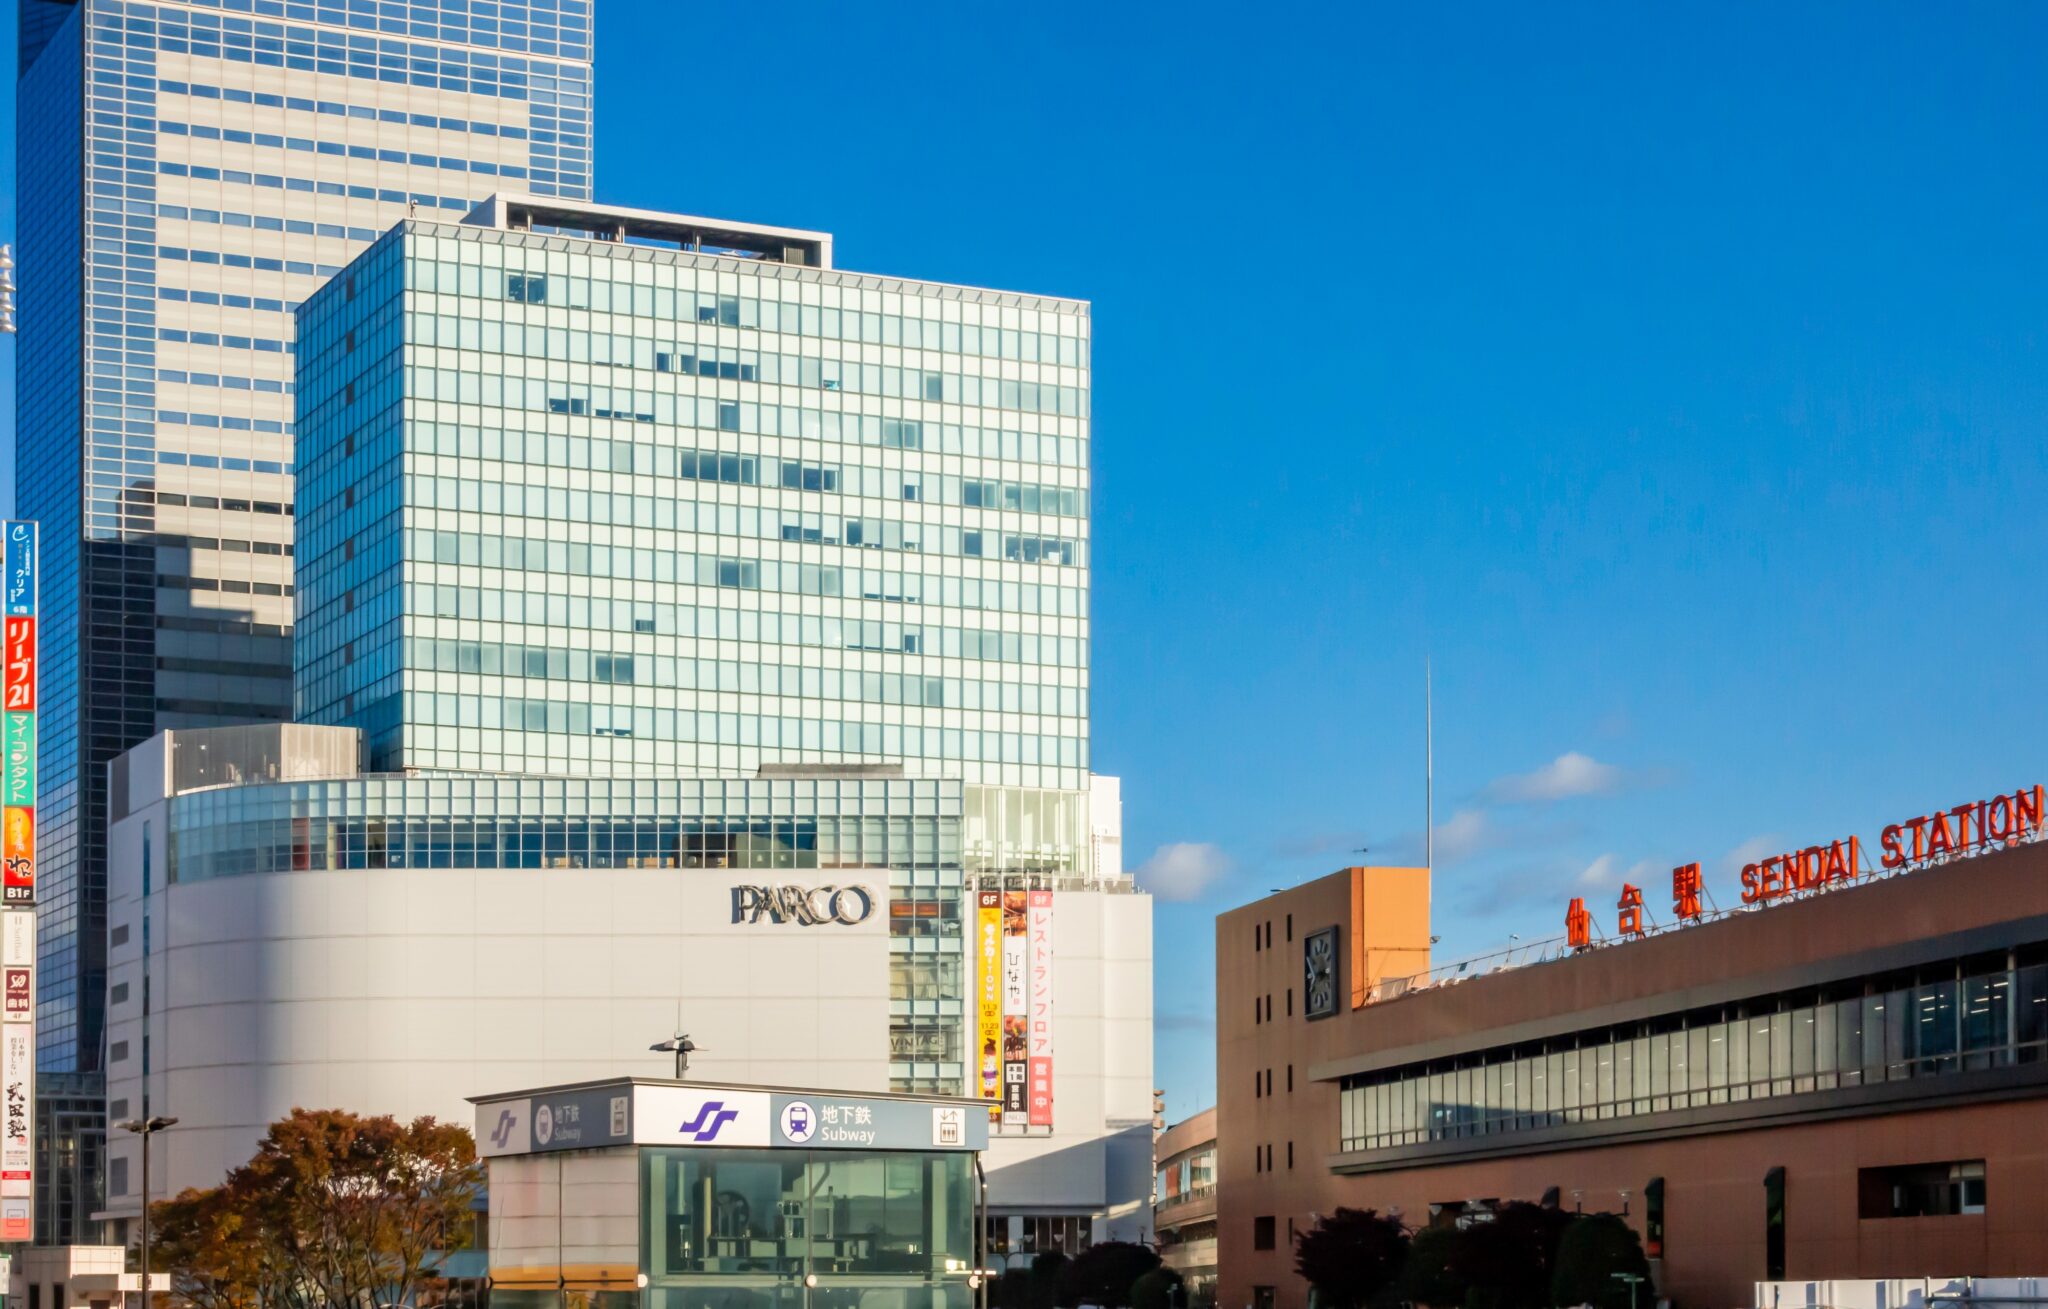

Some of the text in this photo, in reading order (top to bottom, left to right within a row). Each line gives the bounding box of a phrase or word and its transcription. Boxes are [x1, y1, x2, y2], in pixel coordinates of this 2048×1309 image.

[16, 569, 25, 597] クリア
[9, 620, 31, 707] リーブ21
[1740, 784, 2045, 904] SENDAI STATION
[7, 888, 31, 898] B1F
[732, 883, 881, 926] PARCO
[983, 895, 998, 905] 6F
[1034, 895, 1047, 905] 9F
[1565, 862, 1702, 948] 仙台駅
[1007, 952, 1021, 999] ひなや
[1034, 912, 1047, 1051] レストランフロア
[6, 1081, 28, 1139] 武田塾
[555, 1105, 580, 1124] 地下鉄
[821, 1105, 872, 1125] 地下鉄
[555, 1127, 582, 1142] Subway
[821, 1127, 876, 1145] Subway
